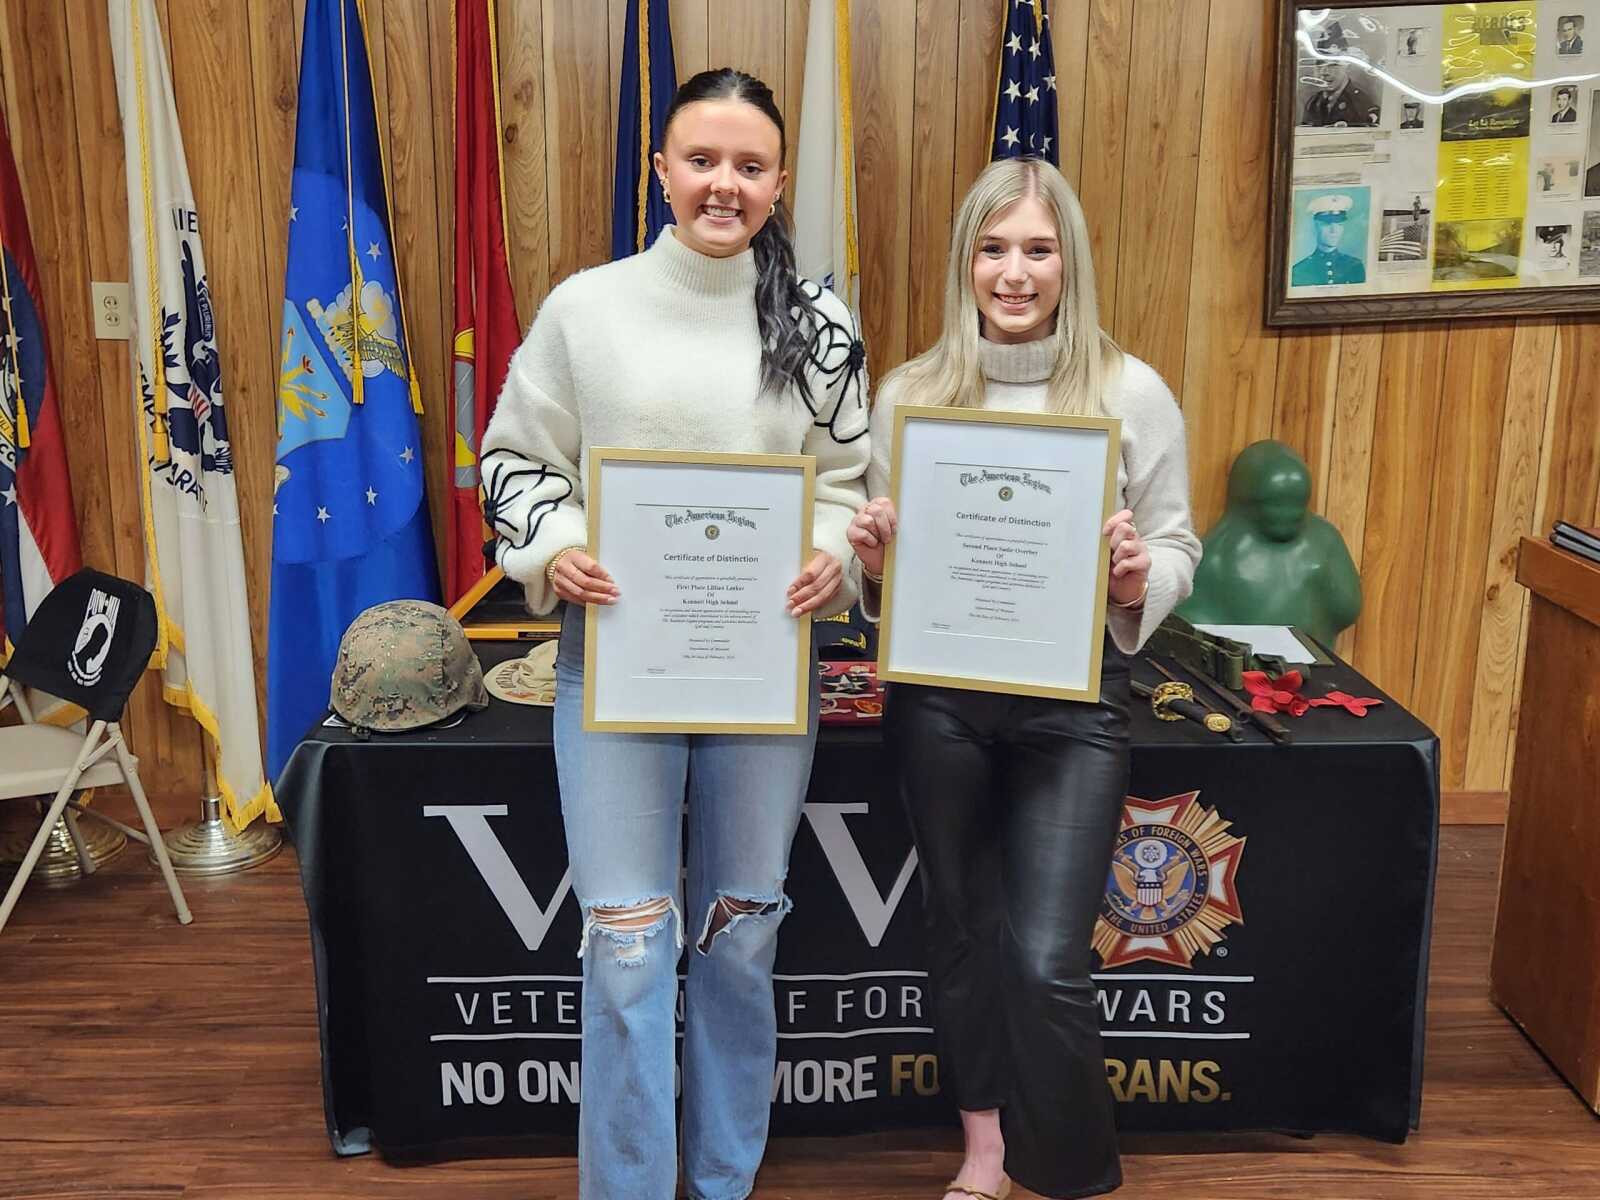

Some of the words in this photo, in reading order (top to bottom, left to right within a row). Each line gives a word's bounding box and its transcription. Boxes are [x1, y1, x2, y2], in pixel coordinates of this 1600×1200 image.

[960, 472, 979, 487] The
[978, 469, 1021, 484] American
[664, 513, 684, 529] The
[684, 509, 726, 525] American
[956, 511, 997, 523] Certificate
[998, 515, 1007, 523] of
[1008, 516, 1052, 528] Distinction
[663, 552, 705, 563] Certificate
[706, 554, 715, 562] of
[716, 554, 759, 563] Distinction
[1132, 827, 1145, 838] OF
[1151, 826, 1193, 847] FOREIGN
[1190, 849, 1208, 878] WARS
[1105, 910, 1123, 927] THE
[1130, 922, 1169, 935] UNITED
[1175, 892, 1205, 925] STATES
[788, 991, 807, 1024] F
[440, 1061, 505, 1106] NO
[517, 1060, 581, 1104] ON
[890, 1054, 941, 1097] FO
